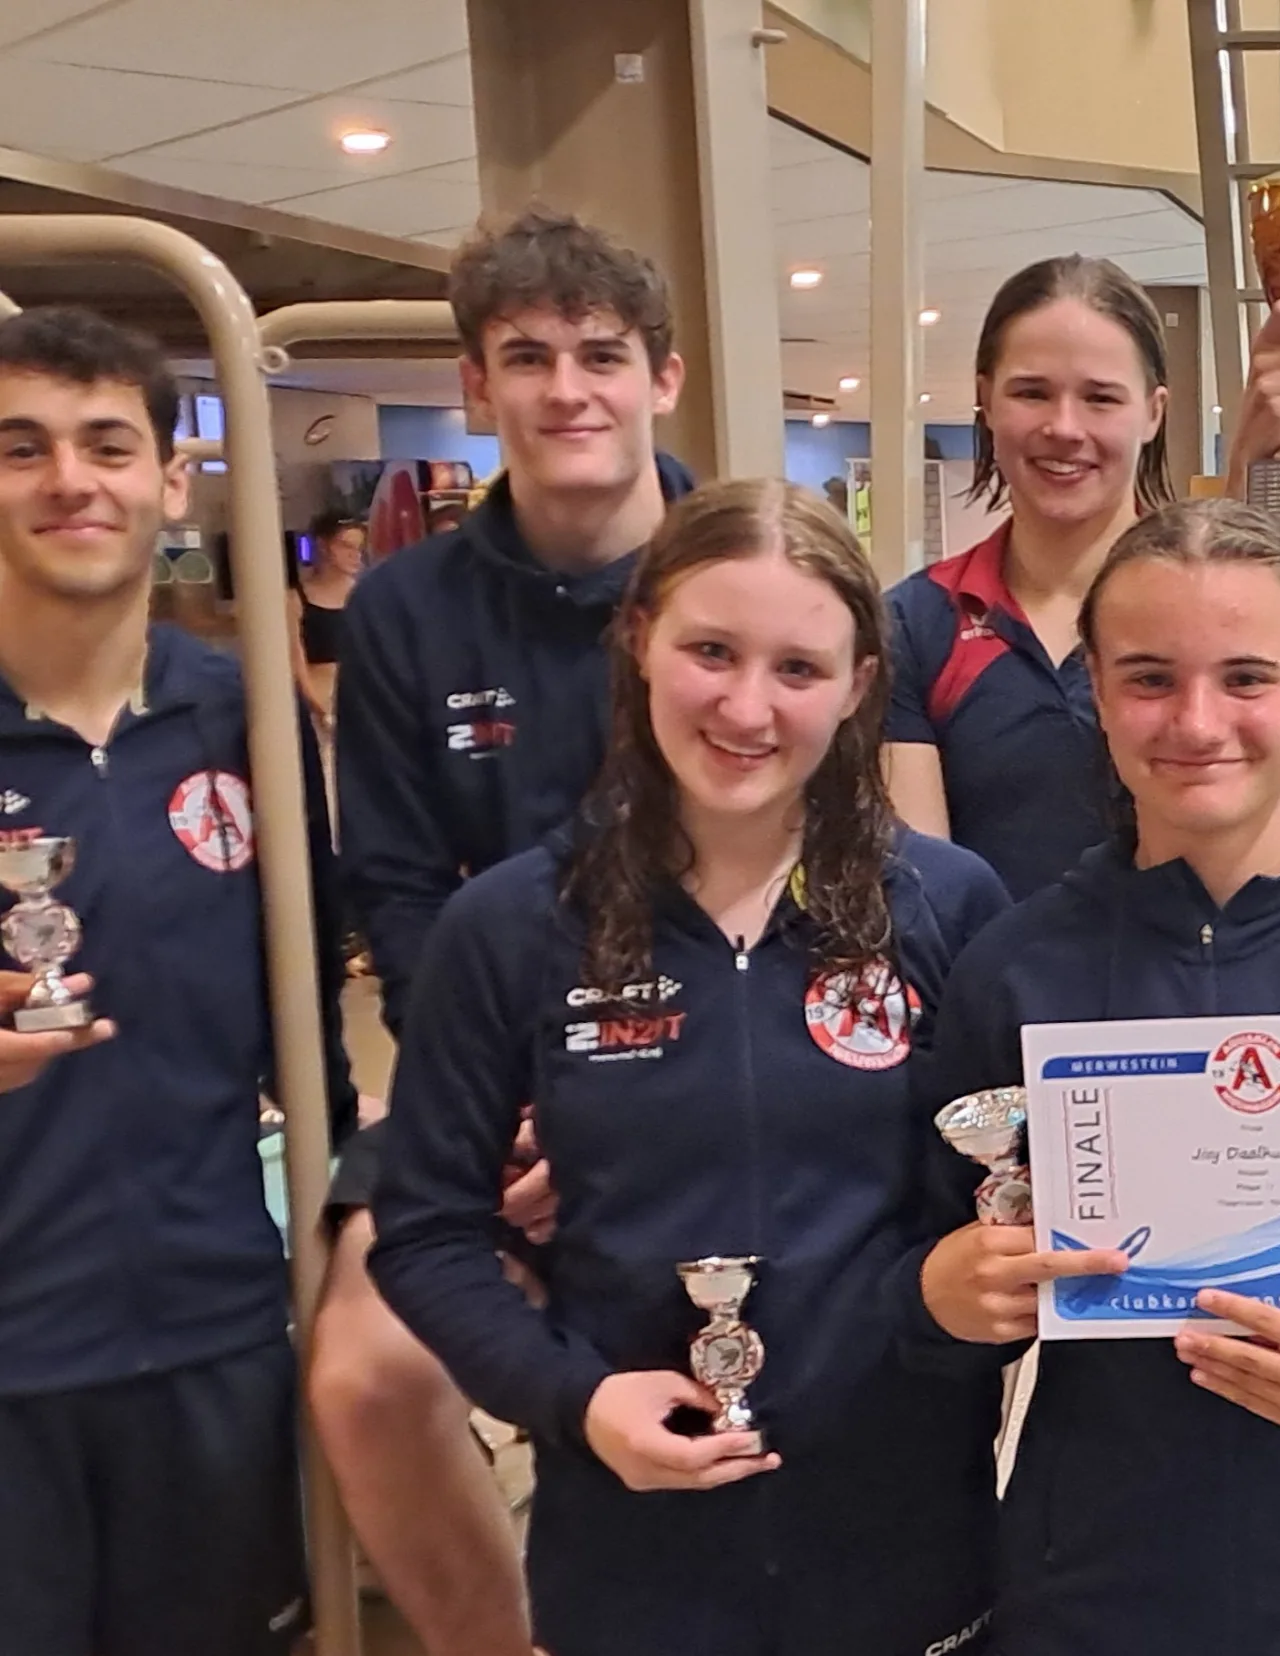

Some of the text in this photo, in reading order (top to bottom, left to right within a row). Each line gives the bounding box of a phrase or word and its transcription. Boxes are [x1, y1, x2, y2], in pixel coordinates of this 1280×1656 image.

[1071, 1057, 1179, 1072] MERWESTEIN
[1071, 1088, 1105, 1220] FINALE
[925, 1608, 993, 1656] CRAFT
